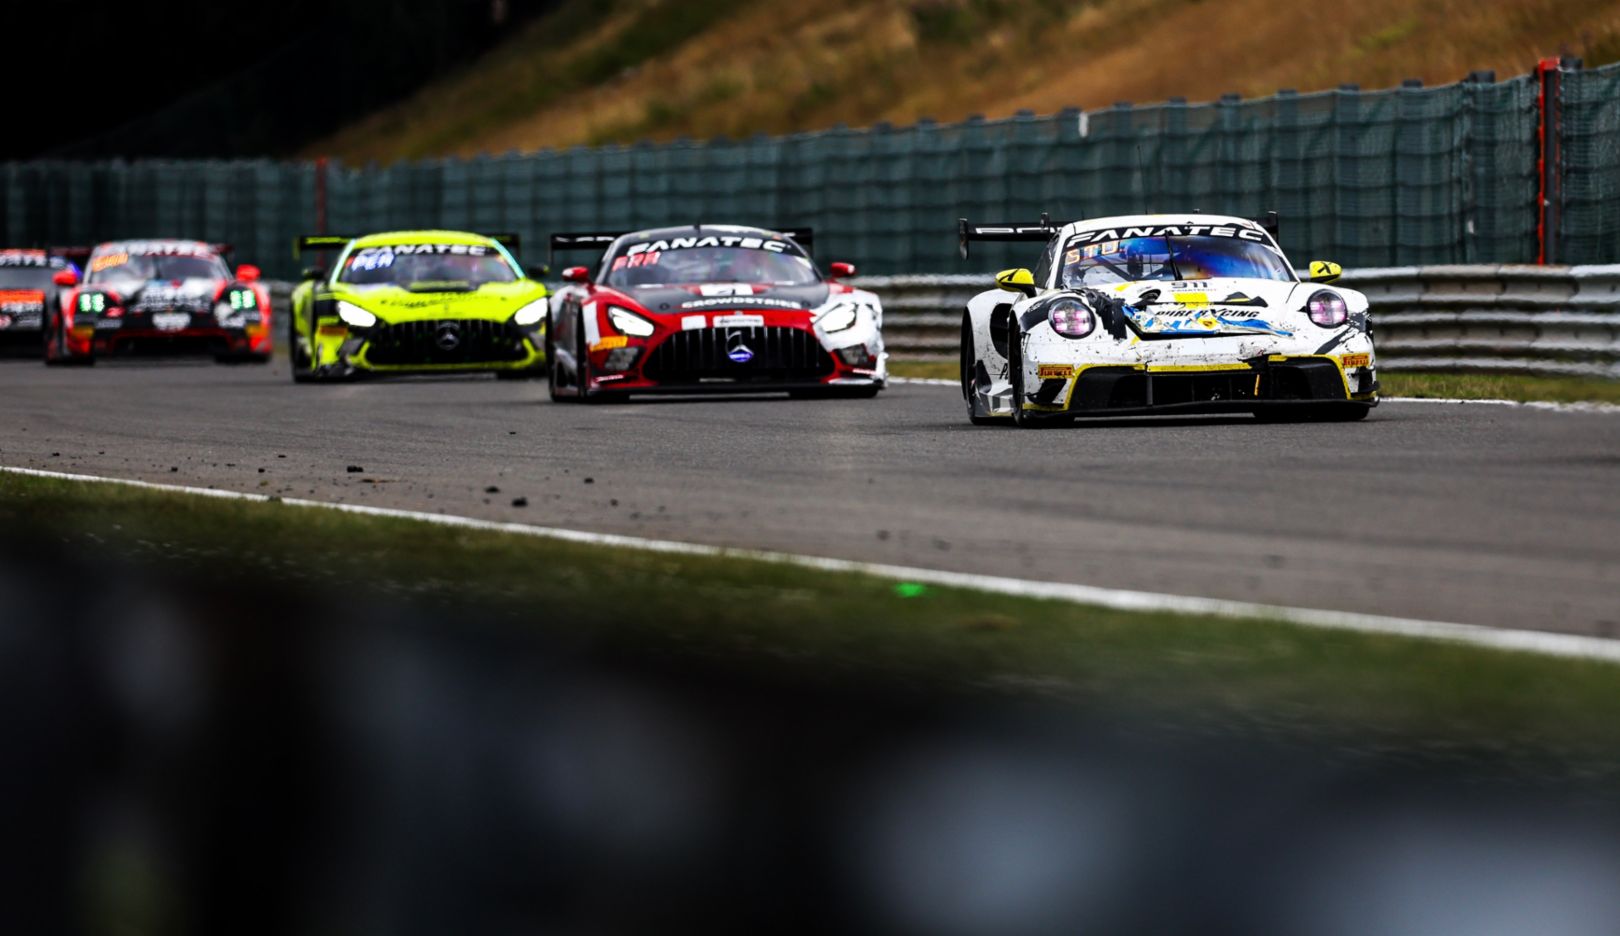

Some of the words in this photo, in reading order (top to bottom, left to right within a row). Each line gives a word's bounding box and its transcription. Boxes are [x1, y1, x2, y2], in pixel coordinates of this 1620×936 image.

[626, 236, 787, 256] FANATEC
[1066, 226, 1265, 247] FANATEC
[1064, 240, 1120, 265] STU
